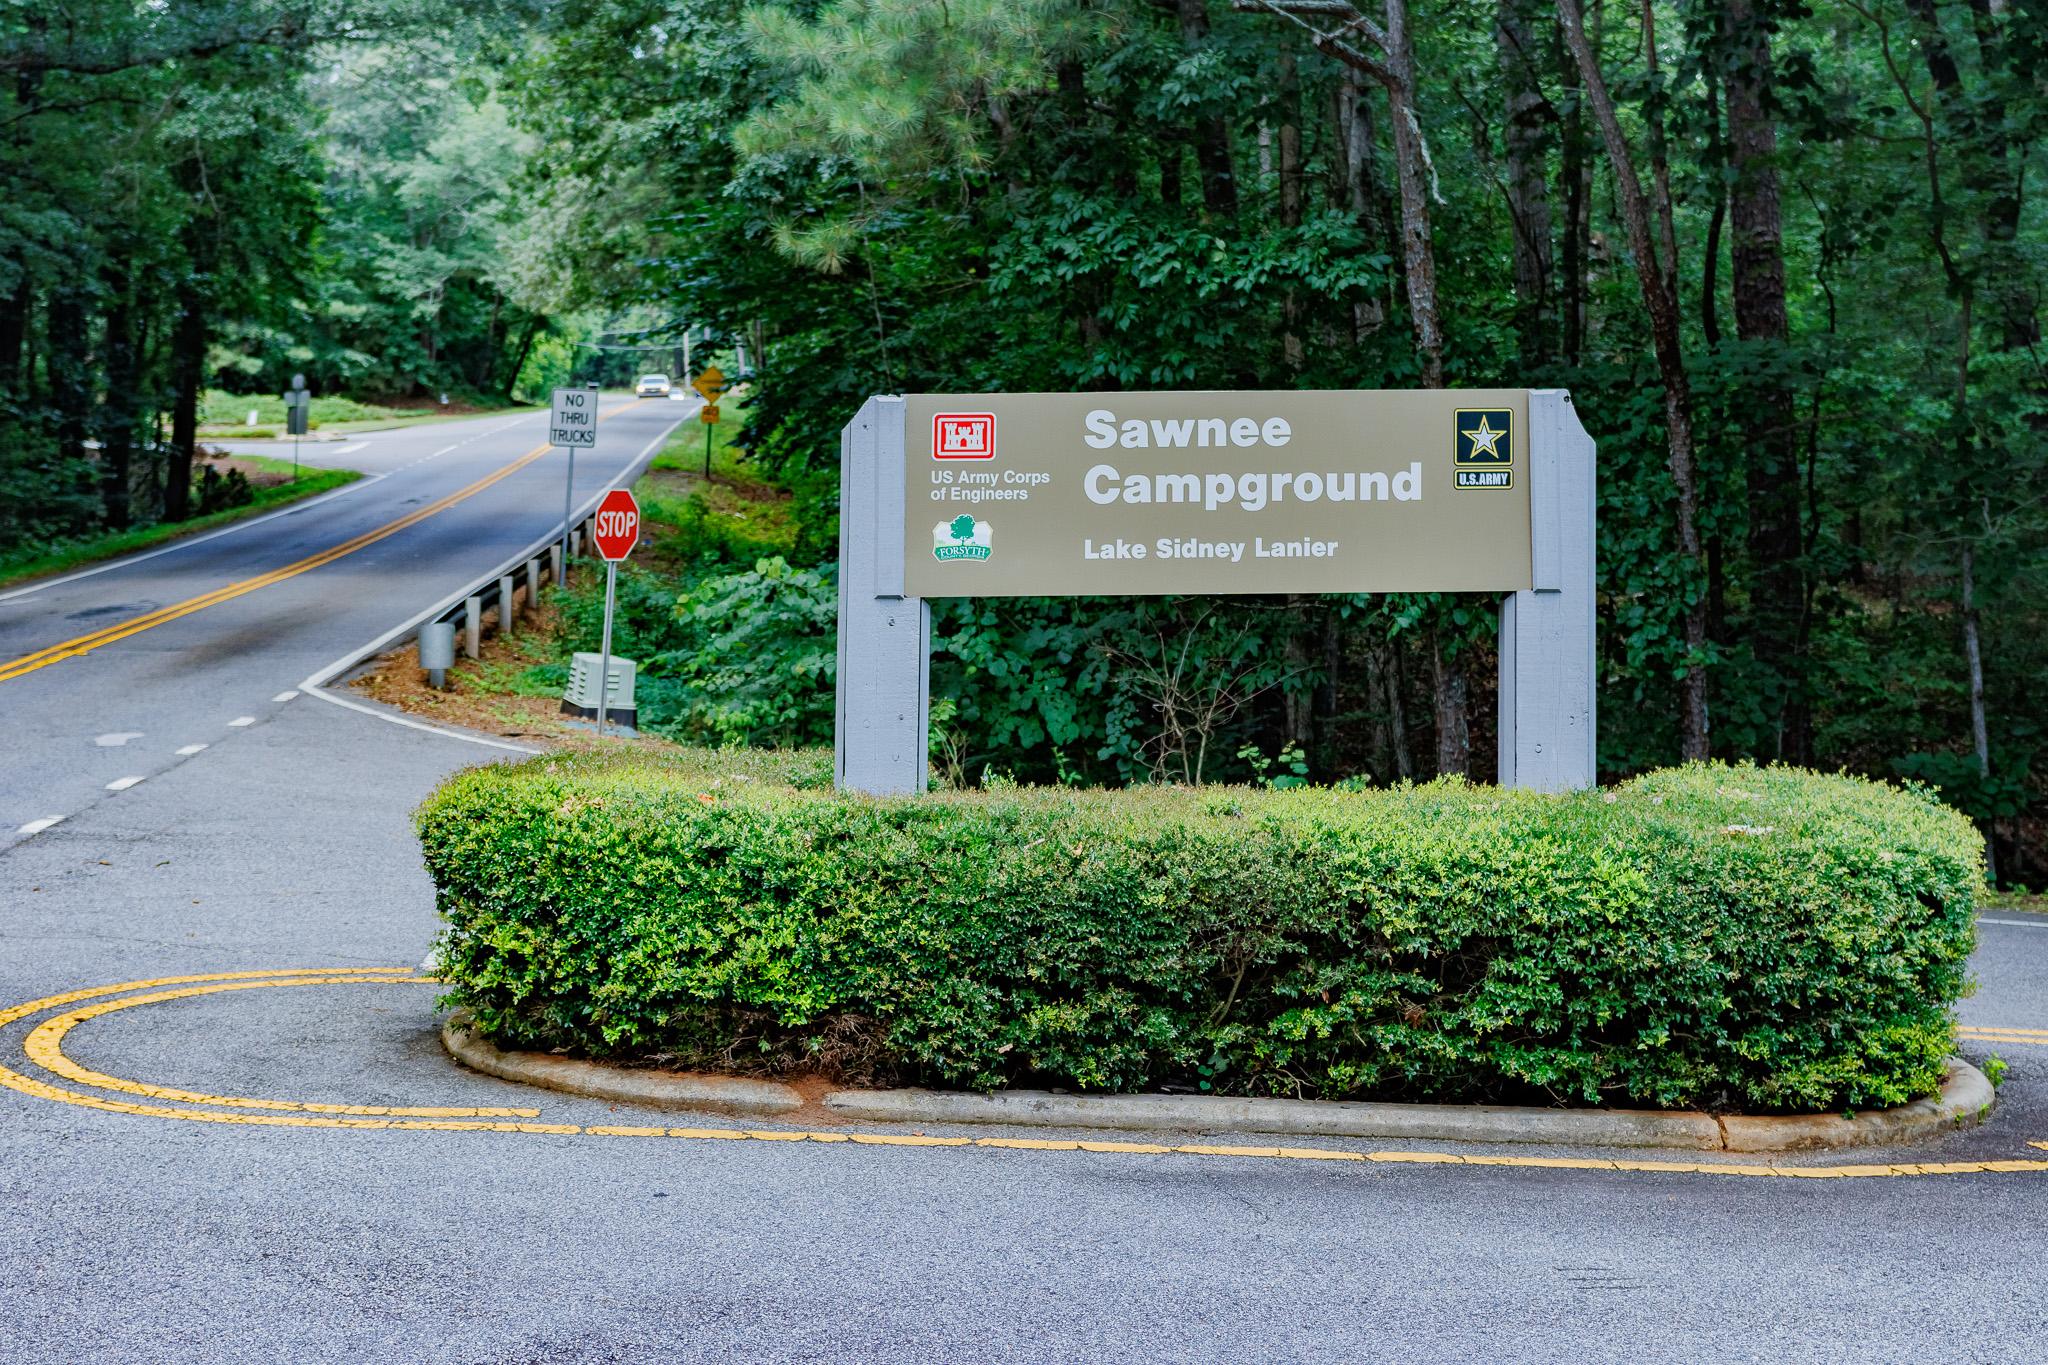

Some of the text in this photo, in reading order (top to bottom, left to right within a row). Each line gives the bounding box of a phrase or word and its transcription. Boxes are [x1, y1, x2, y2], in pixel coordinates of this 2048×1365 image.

[565, 394, 584, 407] NO
[560, 411, 588, 425] THRU
[552, 429, 593, 443] TRUCKS
[1083, 409, 1292, 449] Sawnee
[931, 470, 1051, 487] US Army Corps
[1083, 461, 1423, 512] Campground
[930, 487, 1029, 503] of Engineers
[597, 511, 637, 538] STOP
[940, 546, 986, 556] FORSYTH
[1084, 537, 1339, 562] Lake Sidney Lanier
